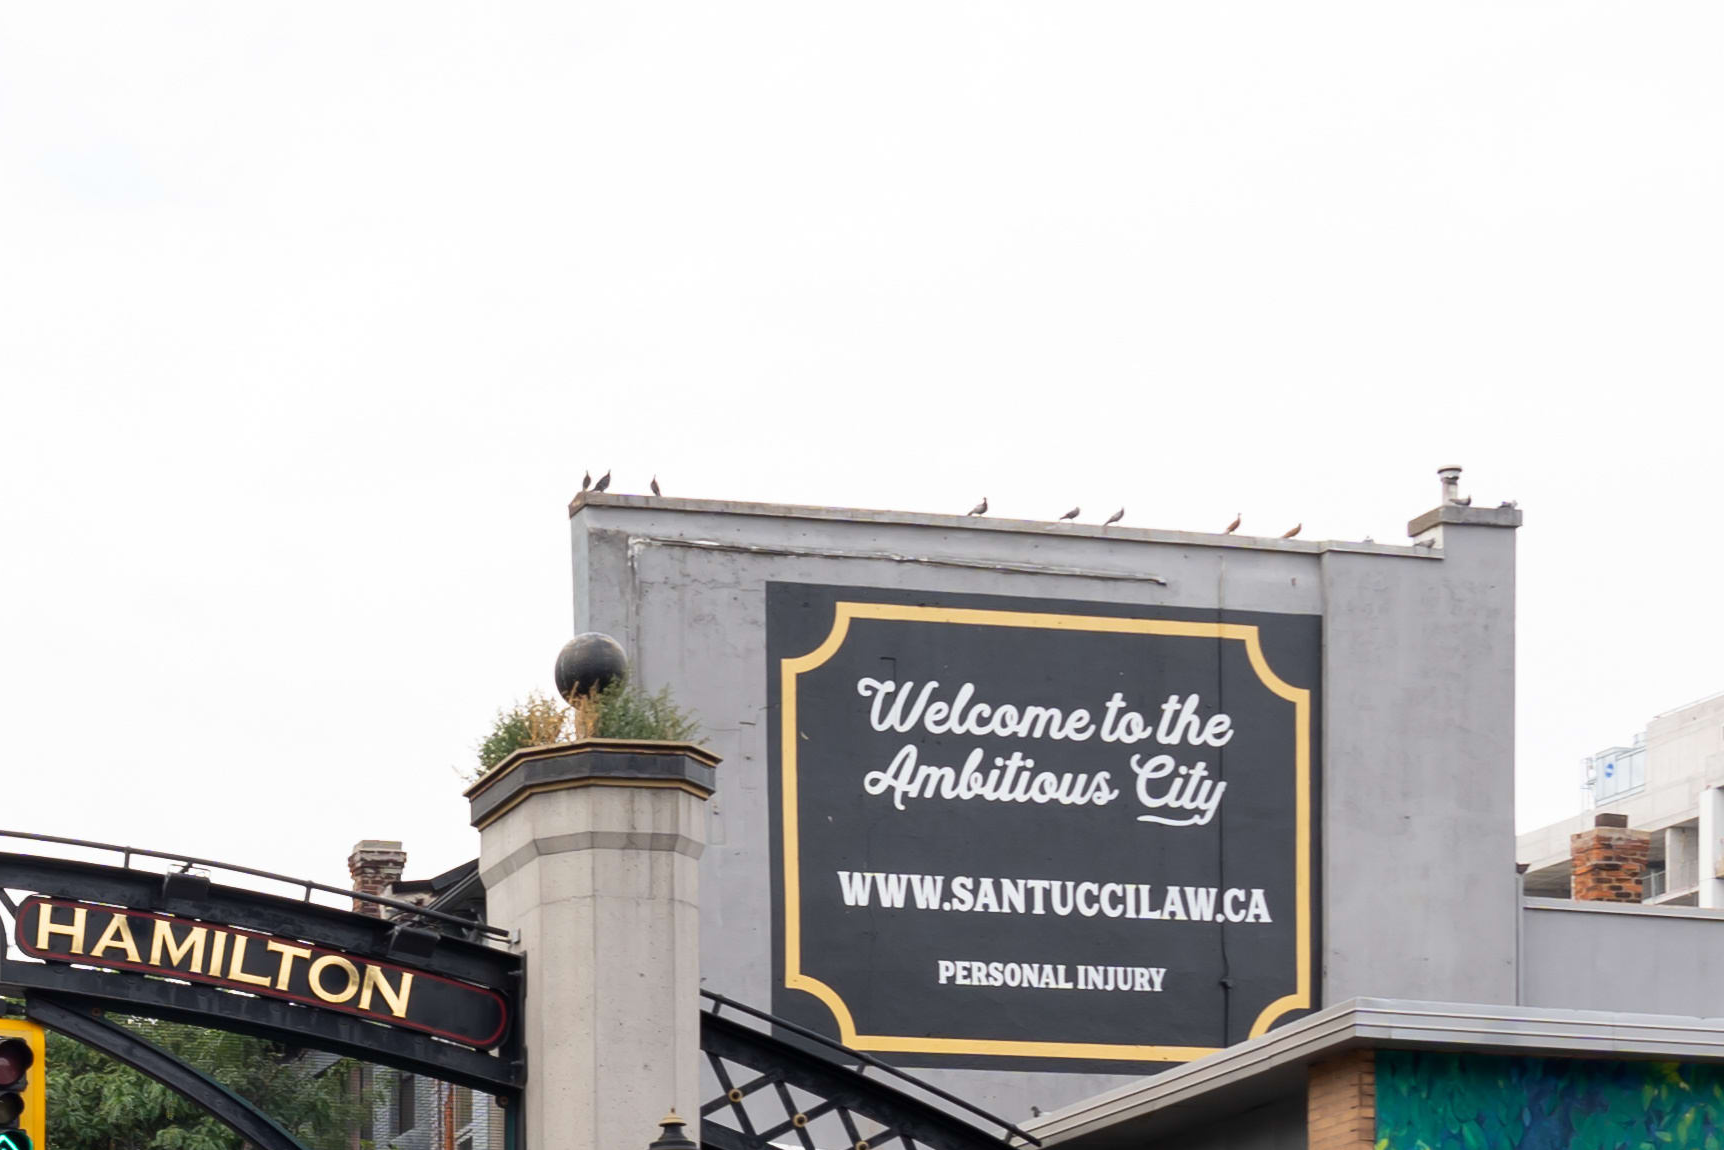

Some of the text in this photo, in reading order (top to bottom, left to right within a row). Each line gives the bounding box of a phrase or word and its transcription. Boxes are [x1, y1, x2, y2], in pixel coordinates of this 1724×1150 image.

[856, 677, 1234, 748] Welcome to the
[863, 744, 1228, 826] Ambitious City
[836, 870, 1273, 924] WWW.SANTUCCILAW.CA
[35, 903, 415, 1020] HAMILTON
[937, 960, 1167, 993] PERSONAL INJURY
